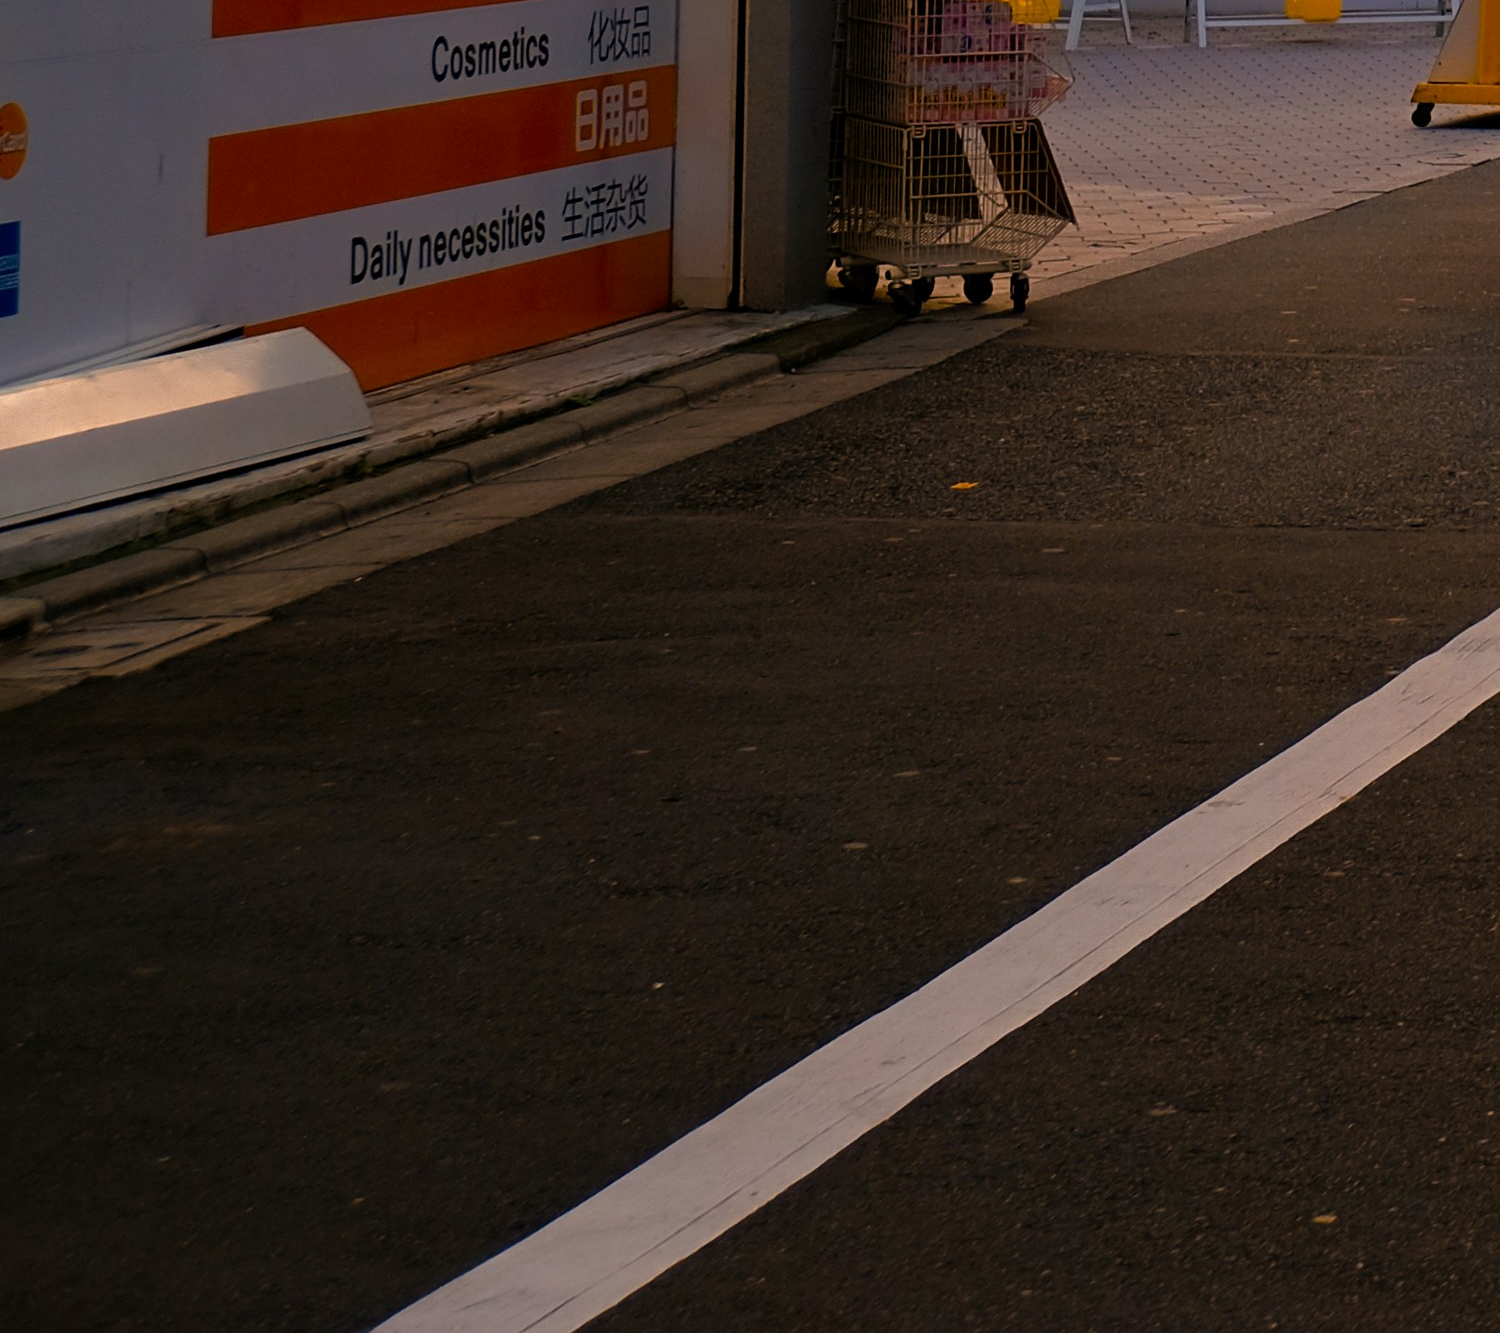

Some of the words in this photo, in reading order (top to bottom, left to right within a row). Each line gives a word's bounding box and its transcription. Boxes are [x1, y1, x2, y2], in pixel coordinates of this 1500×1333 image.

[431, 31, 550, 83] Cosmetics
[587, 5, 652, 65] 化妆品
[575, 79, 649, 153] 日用品
[350, 229, 410, 287] Daily
[419, 205, 547, 271] necessities
[561, 173, 649, 245] 生活杂货
